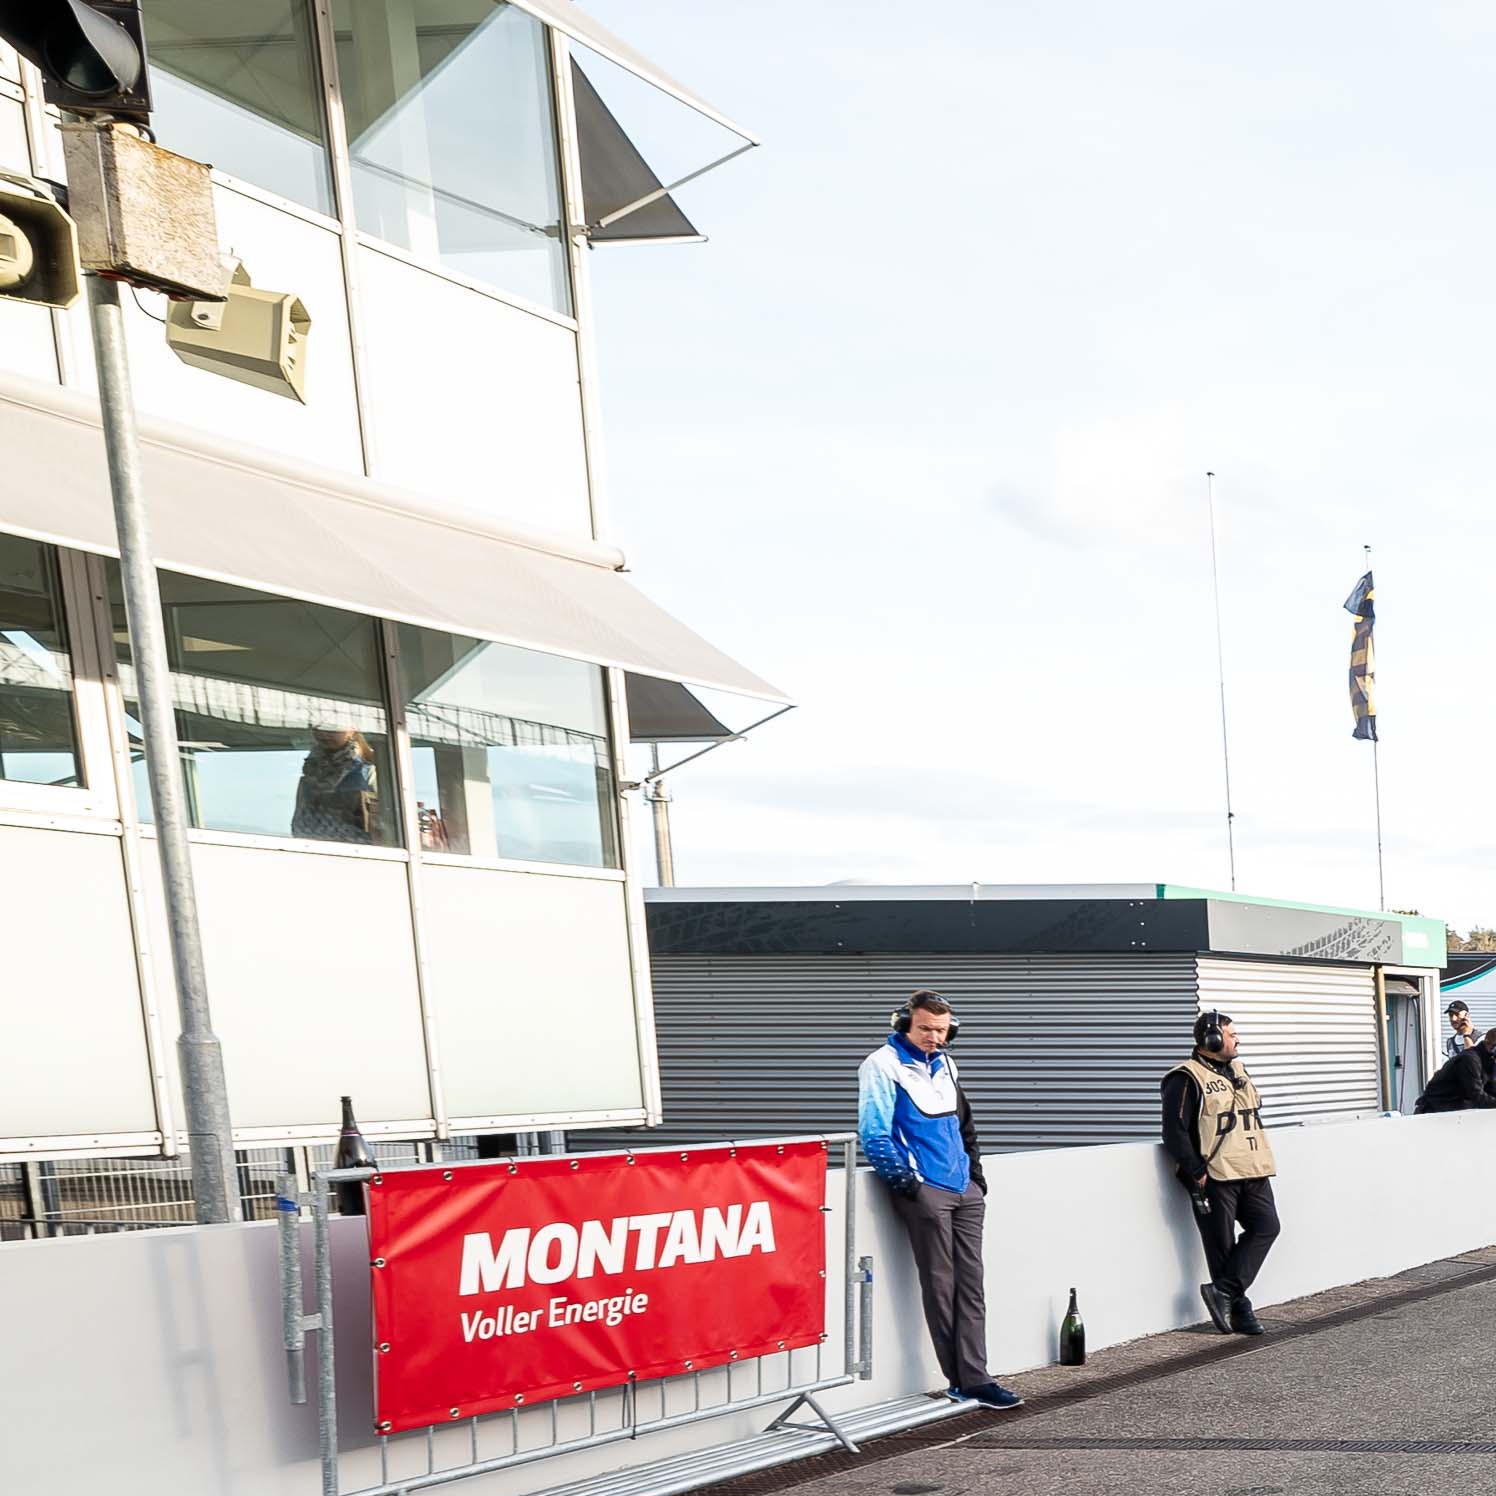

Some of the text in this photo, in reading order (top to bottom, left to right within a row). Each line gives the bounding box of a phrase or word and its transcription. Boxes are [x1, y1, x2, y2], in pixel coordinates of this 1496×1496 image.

[1205, 1079, 1227, 1095] 303
[459, 1200, 777, 1297] MONTANA
[460, 1287, 648, 1343] Voller Energie
